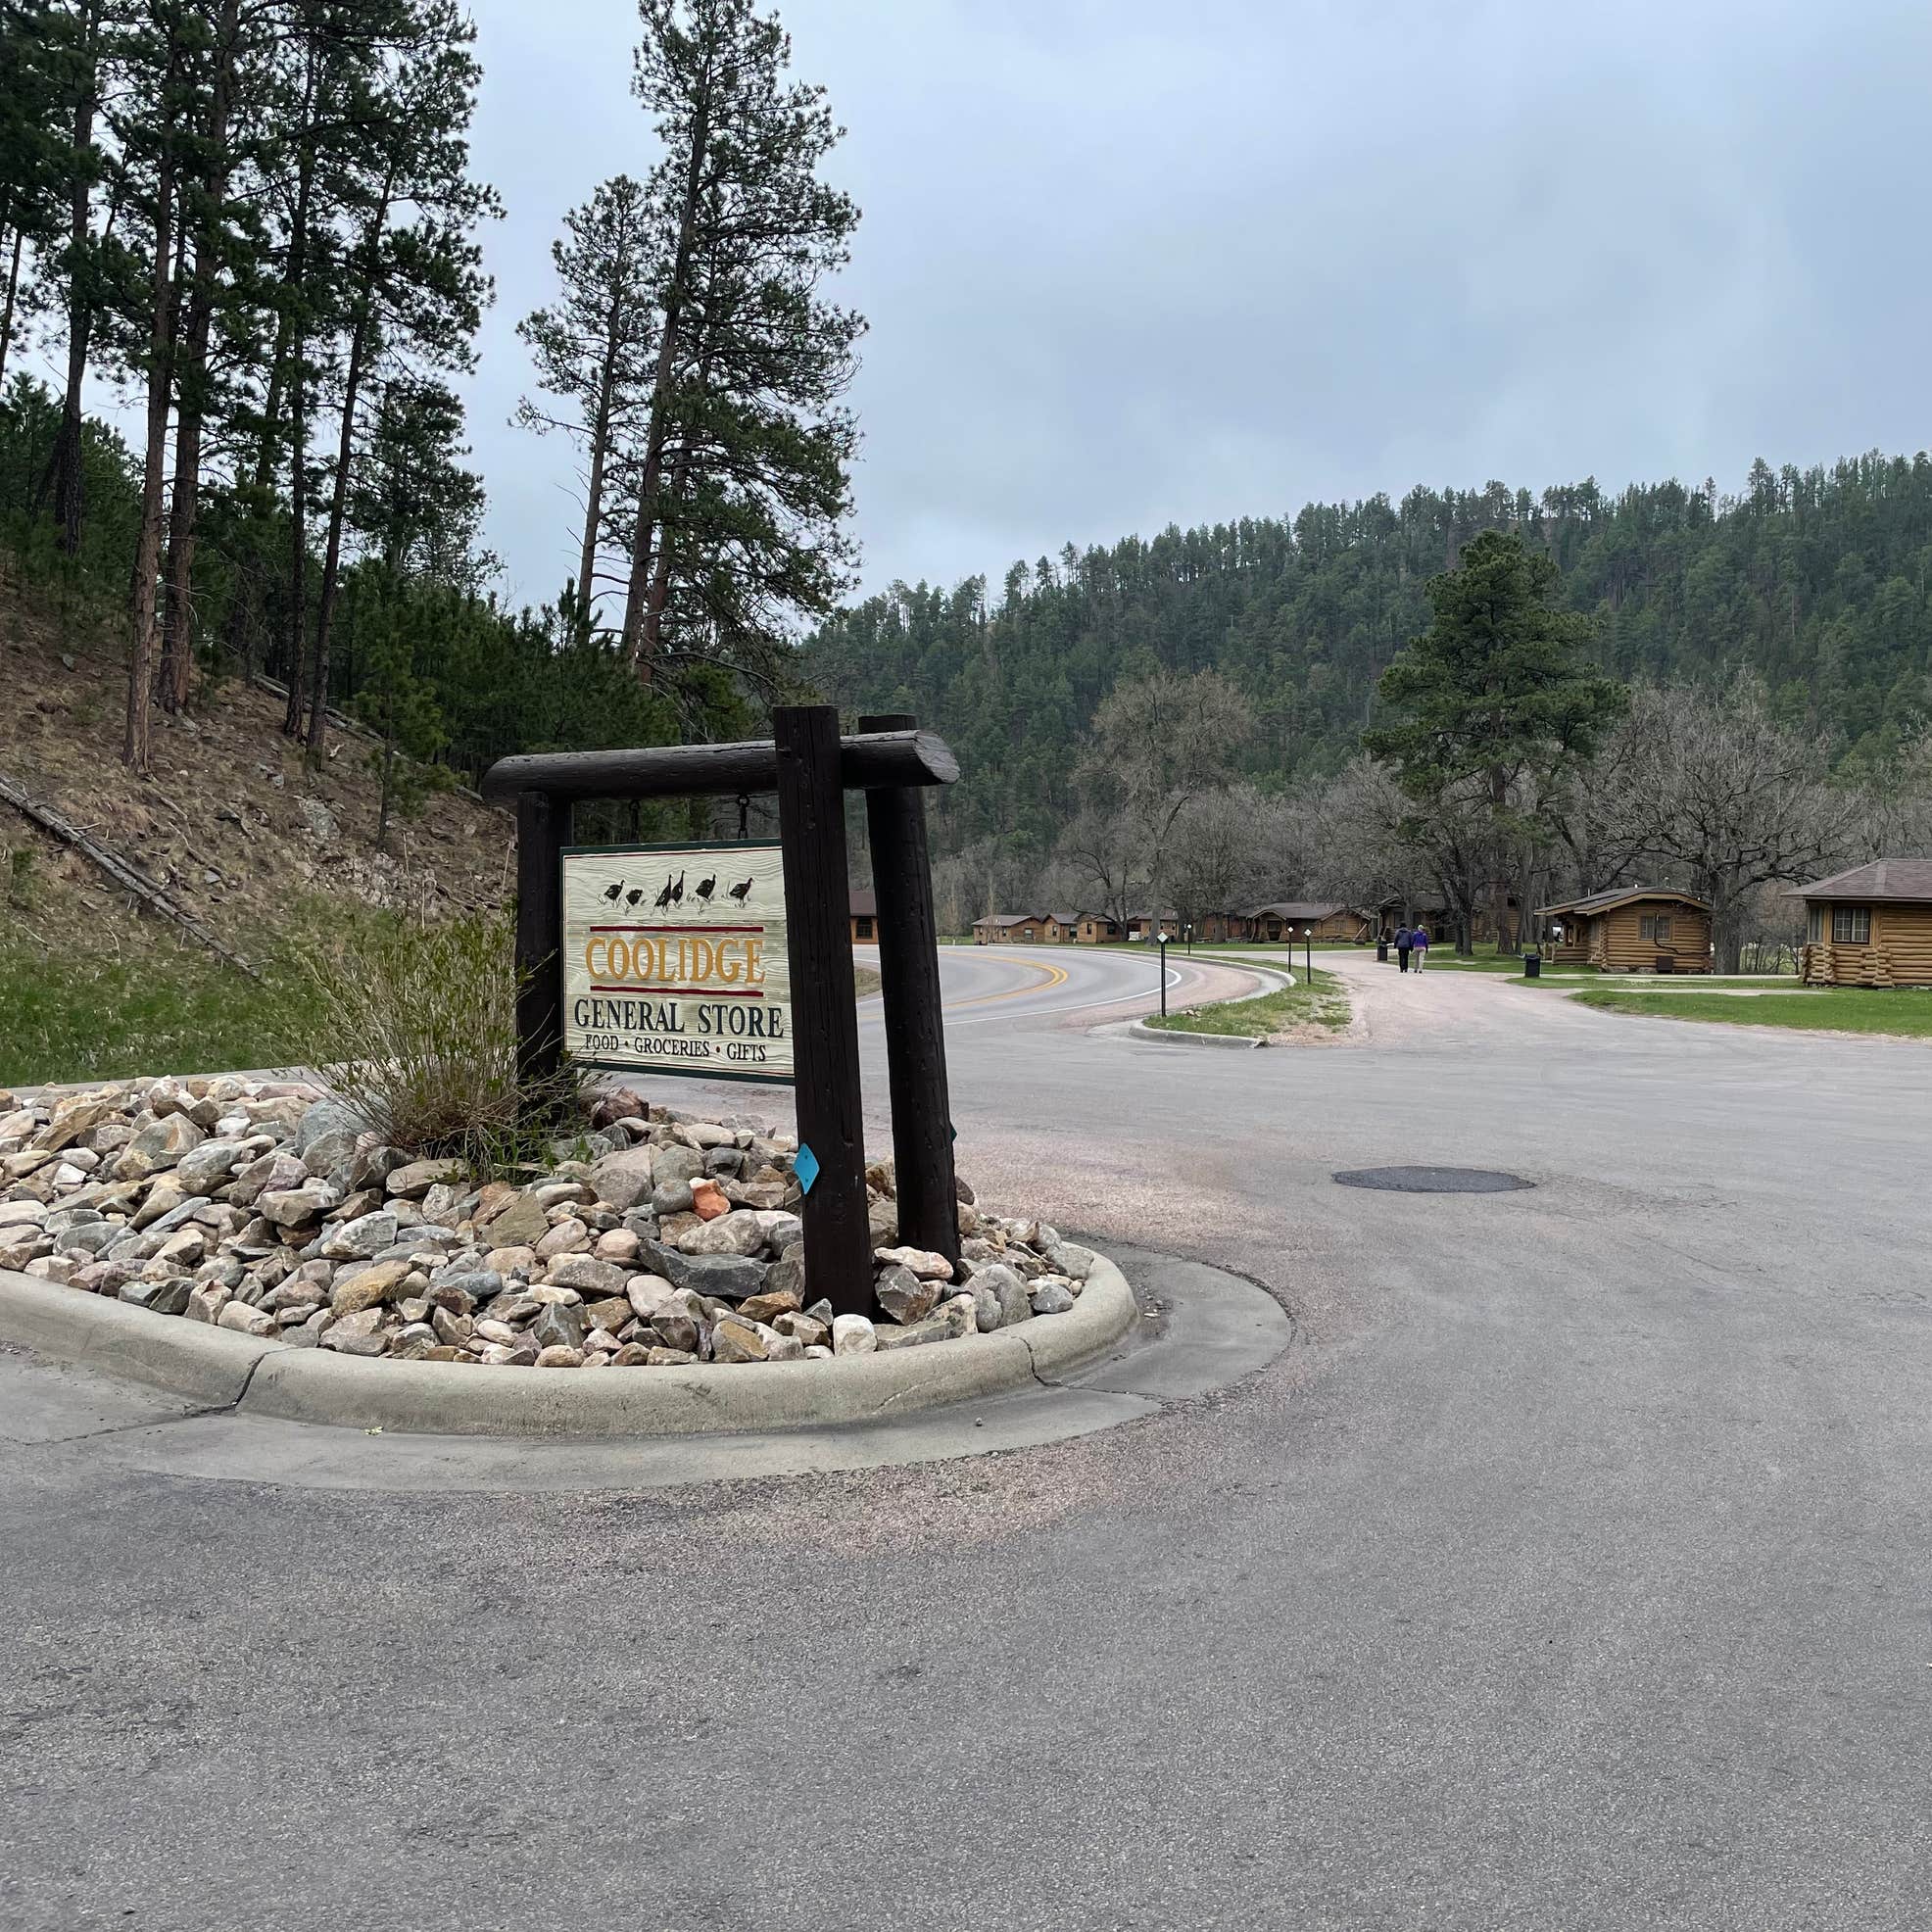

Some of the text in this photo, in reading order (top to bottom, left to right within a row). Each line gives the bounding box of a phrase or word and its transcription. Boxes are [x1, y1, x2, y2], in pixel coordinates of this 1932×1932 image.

[585, 937, 766, 984] COOLIDGE
[574, 998, 784, 1038] GENERAL STORE
[585, 1034, 766, 1062] FOOD GROCERIES GIFTS
